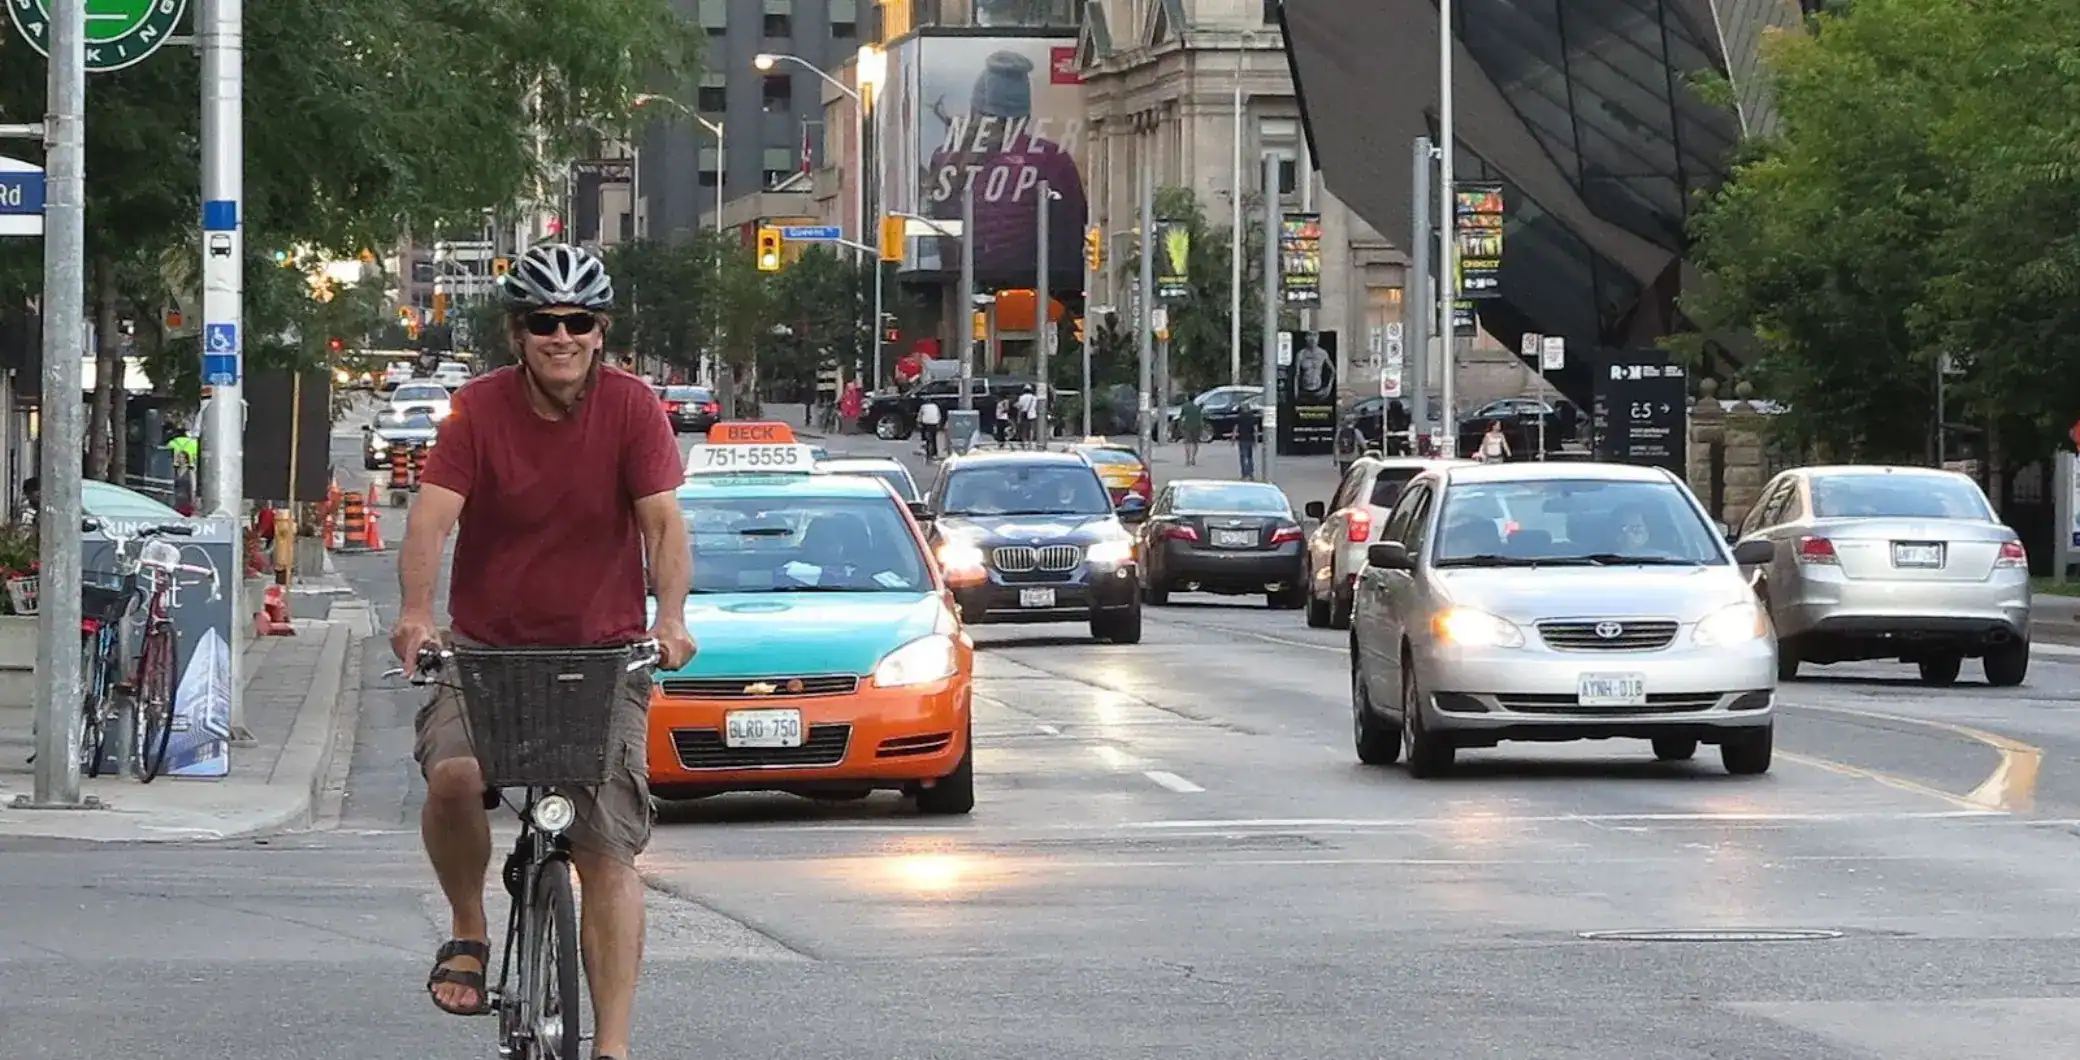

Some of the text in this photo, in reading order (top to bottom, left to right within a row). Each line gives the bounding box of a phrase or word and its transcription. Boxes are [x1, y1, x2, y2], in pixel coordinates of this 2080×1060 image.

[17, 0, 175, 62] PAKING
[942, 115, 1083, 154] NEVER
[932, 164, 1038, 202] STOP
[728, 426, 775, 440] BECK
[704, 447, 798, 466] 751-5555
